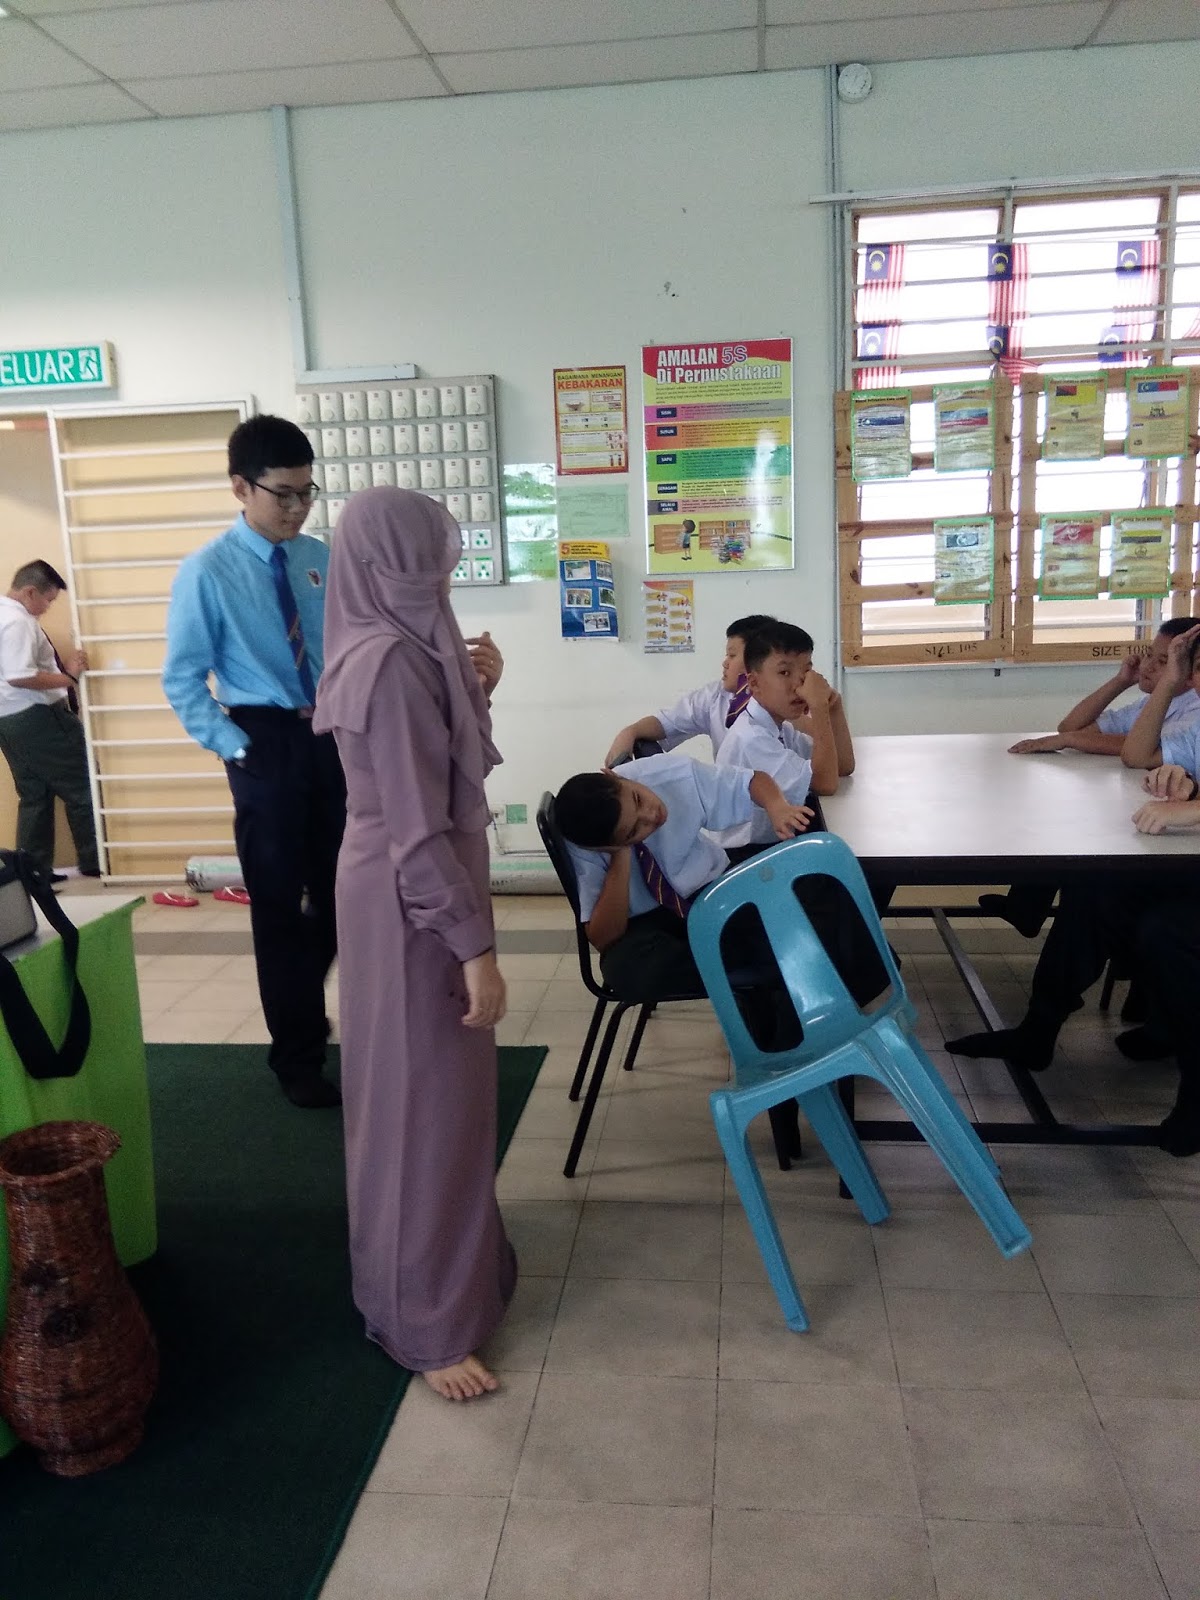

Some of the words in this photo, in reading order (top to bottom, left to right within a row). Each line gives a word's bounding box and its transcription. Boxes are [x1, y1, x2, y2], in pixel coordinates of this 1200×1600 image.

[657, 347, 718, 367] AMALAN
[721, 344, 748, 365] 5S
[0, 350, 76, 385] ELUAR
[656, 368, 672, 385] Di
[675, 363, 781, 384] Perpustakaan
[557, 379, 623, 389] KEBAKARAN
[561, 543, 570, 555] 5
[1092, 645, 1122, 658] SIZE
